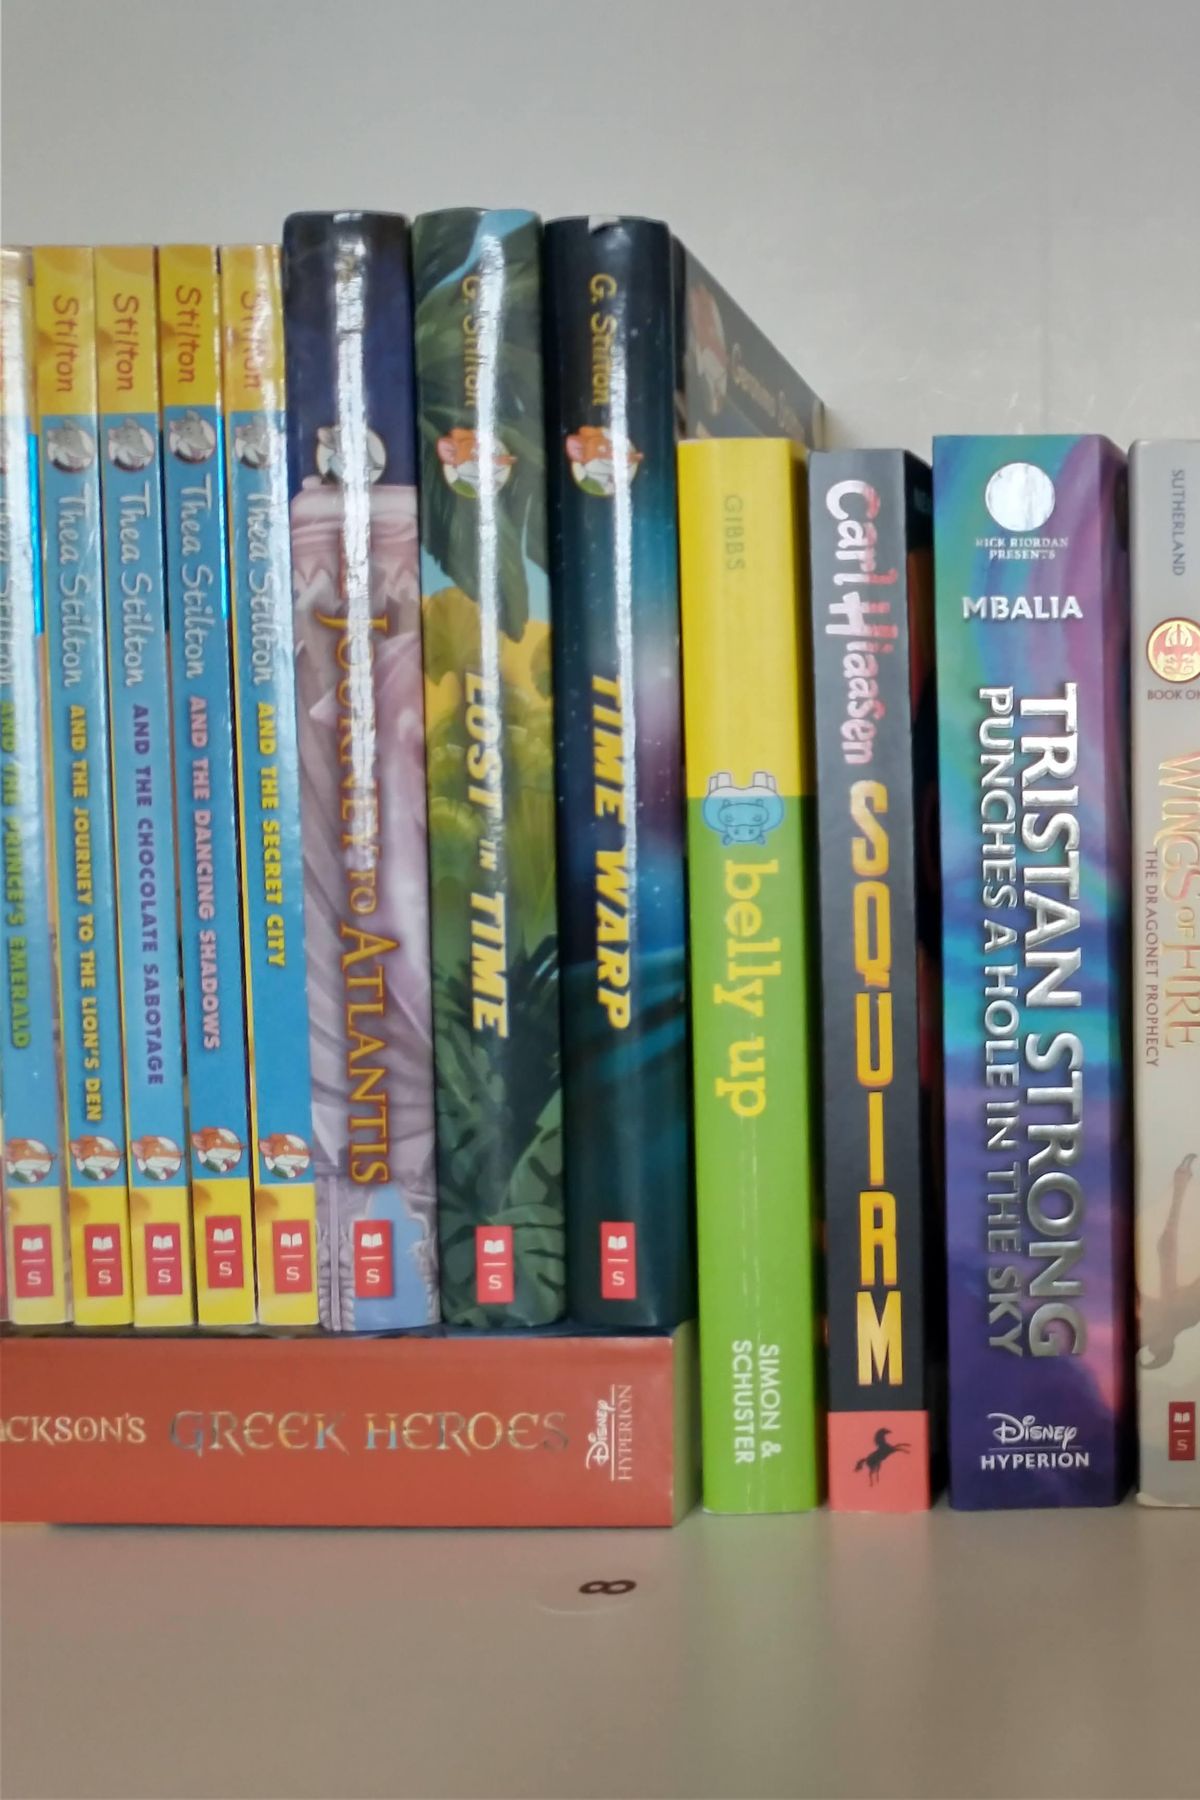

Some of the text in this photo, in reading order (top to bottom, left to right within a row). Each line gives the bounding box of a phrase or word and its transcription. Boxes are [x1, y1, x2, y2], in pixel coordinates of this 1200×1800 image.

[53, 295, 80, 393] Stilton
[113, 292, 141, 391] Stilton
[175, 285, 203, 383] Stilton
[590, 274, 617, 405] G. Stilton
[723, 495, 745, 571] GIBBS
[975, 537, 1069, 548] RICK RIORDAN
[989, 550, 1056, 560] PRESENTS
[1171, 469, 1185, 576] SUTHERLAND
[825, 480, 899, 765] Carl Hiaasen
[962, 596, 1083, 620] MBALIA
[247, 491, 285, 967] Thea Stilton AND THE SECRET CITY
[1147, 690, 1183, 700] BOOK
[2, 762, 23, 808] THE
[58, 483, 103, 1120] Thea Stilton AND THE JOURNEY TO THE LION'S DEN
[119, 482, 164, 1085] Thea Stilton AND THE CHOCOLATE SABOTAGE
[180, 474, 221, 1049] Thea Stilton AND THE DANCING SHADOWS
[5, 816, 27, 925] PRINCE'S
[350, 870, 378, 912] TO
[464, 672, 508, 1039] LOST IN TIME
[592, 675, 631, 1029] TIME WARP
[1145, 848, 1160, 1067] THE DRAGONET PROPHECY
[1177, 906, 1196, 938] OF
[9, 937, 30, 1048] EMERALD
[714, 858, 781, 1117] belly up
[978, 686, 1023, 1357] PUNCHES A HOLE IN THE SKY
[1019, 683, 1086, 1357] TRISTAN STRONG
[341, 928, 400, 1184] ATLANTIS
[851, 779, 903, 1387] SQUIRM
[168, 1409, 350, 1457] GREEK
[365, 1409, 571, 1457] HEROES
[618, 1384, 633, 1480] HYPERION
[732, 1339, 755, 1464] SCHUSTER
[758, 1344, 782, 1458] SIMON &
[980, 1452, 1089, 1470] HYPERION
